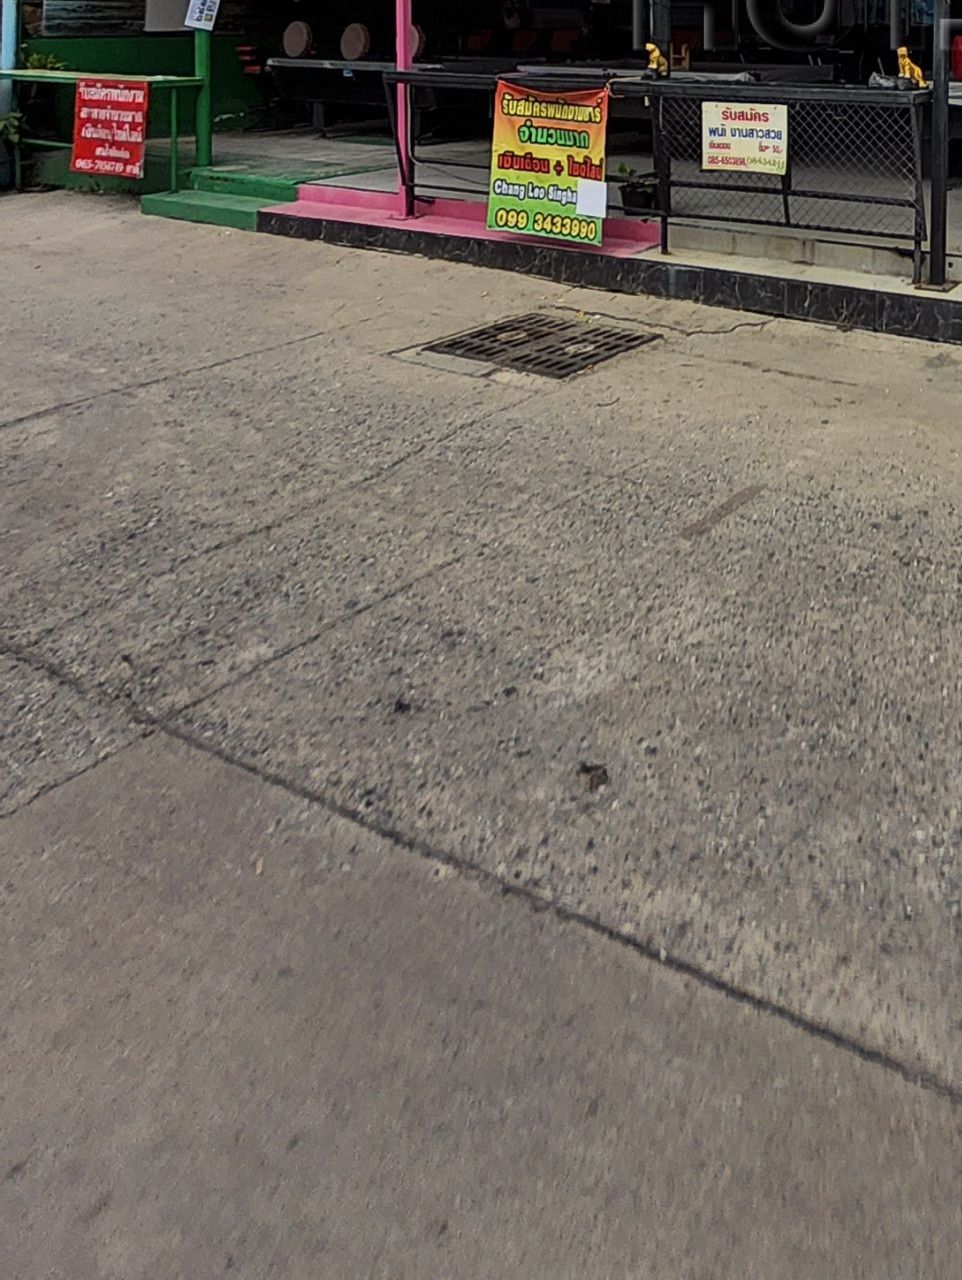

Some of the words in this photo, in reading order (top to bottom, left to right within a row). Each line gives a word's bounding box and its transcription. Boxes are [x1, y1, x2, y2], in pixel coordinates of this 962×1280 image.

[721, 107, 769, 122] รับสมัคร
[518, 119, 589, 148] จำนวนมาก
[494, 179, 526, 200] Chang
[527, 182, 545, 199] Leo
[496, 208, 528, 229] 099
[533, 212, 596, 240] 3433990
